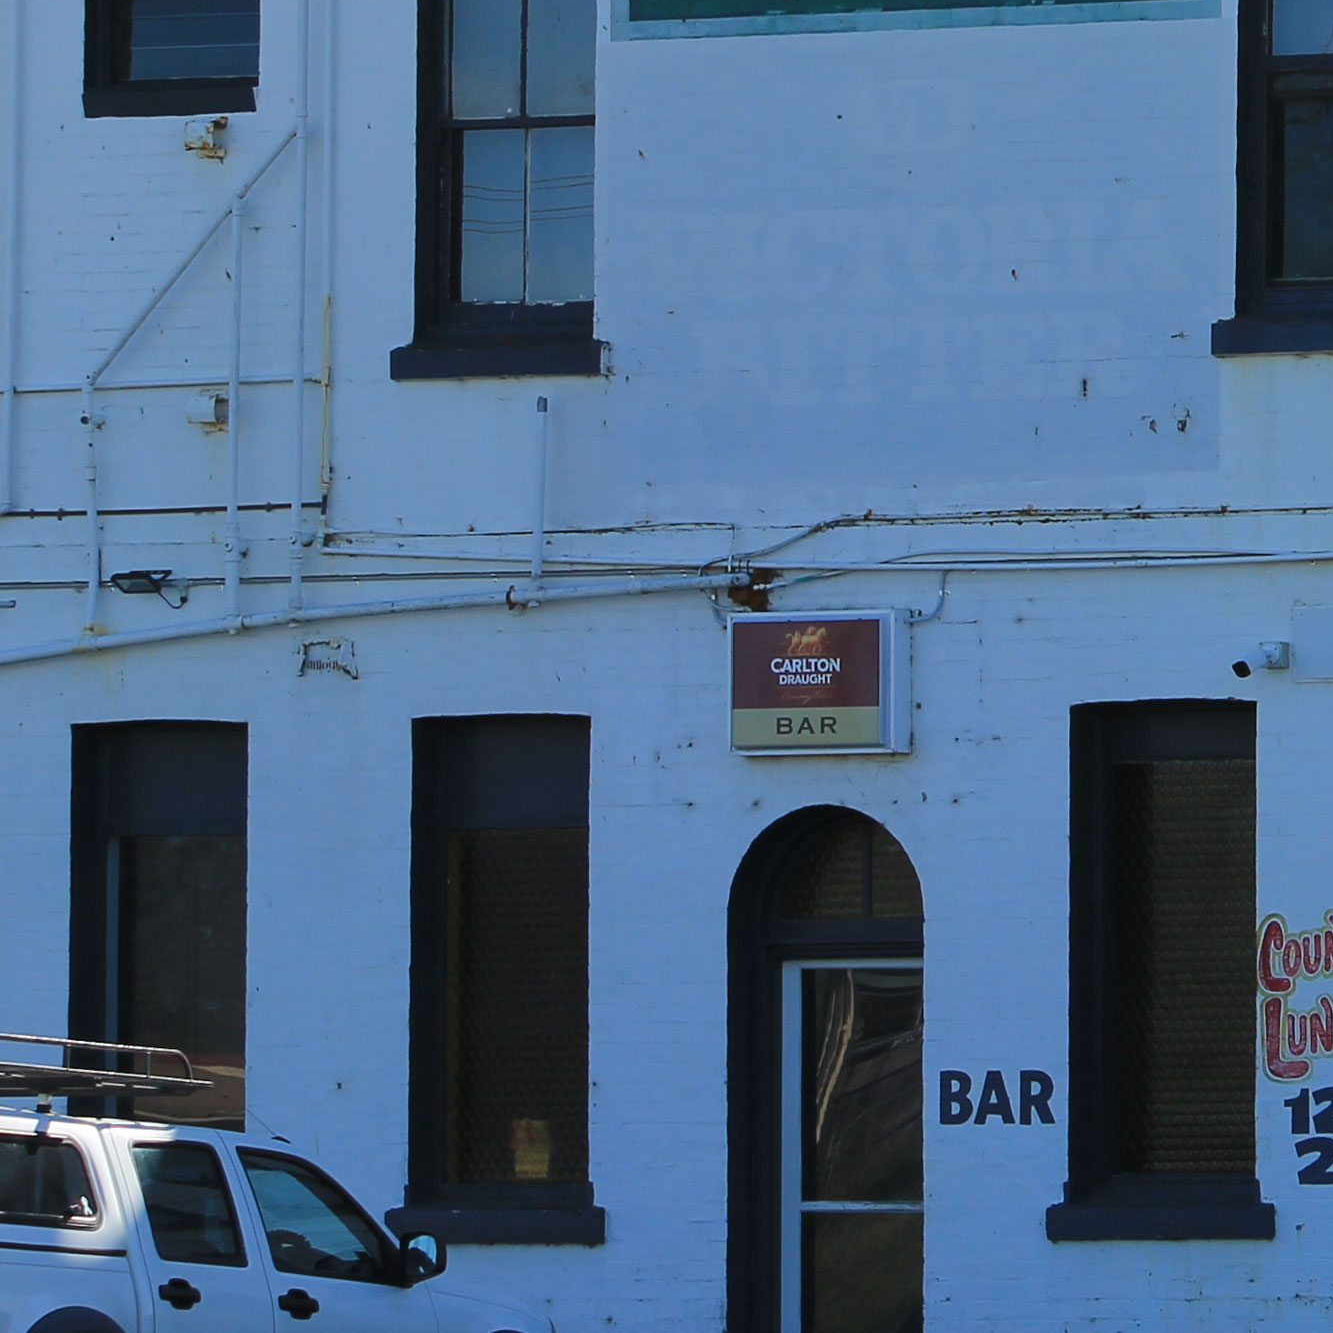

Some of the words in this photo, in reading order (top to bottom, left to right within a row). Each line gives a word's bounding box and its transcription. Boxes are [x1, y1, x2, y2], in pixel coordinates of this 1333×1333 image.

[770, 657, 841, 673] CARLTON
[779, 674, 833, 685] DRAUGHT
[776, 716, 837, 735] BAR
[939, 1069, 1056, 1126] BAR
